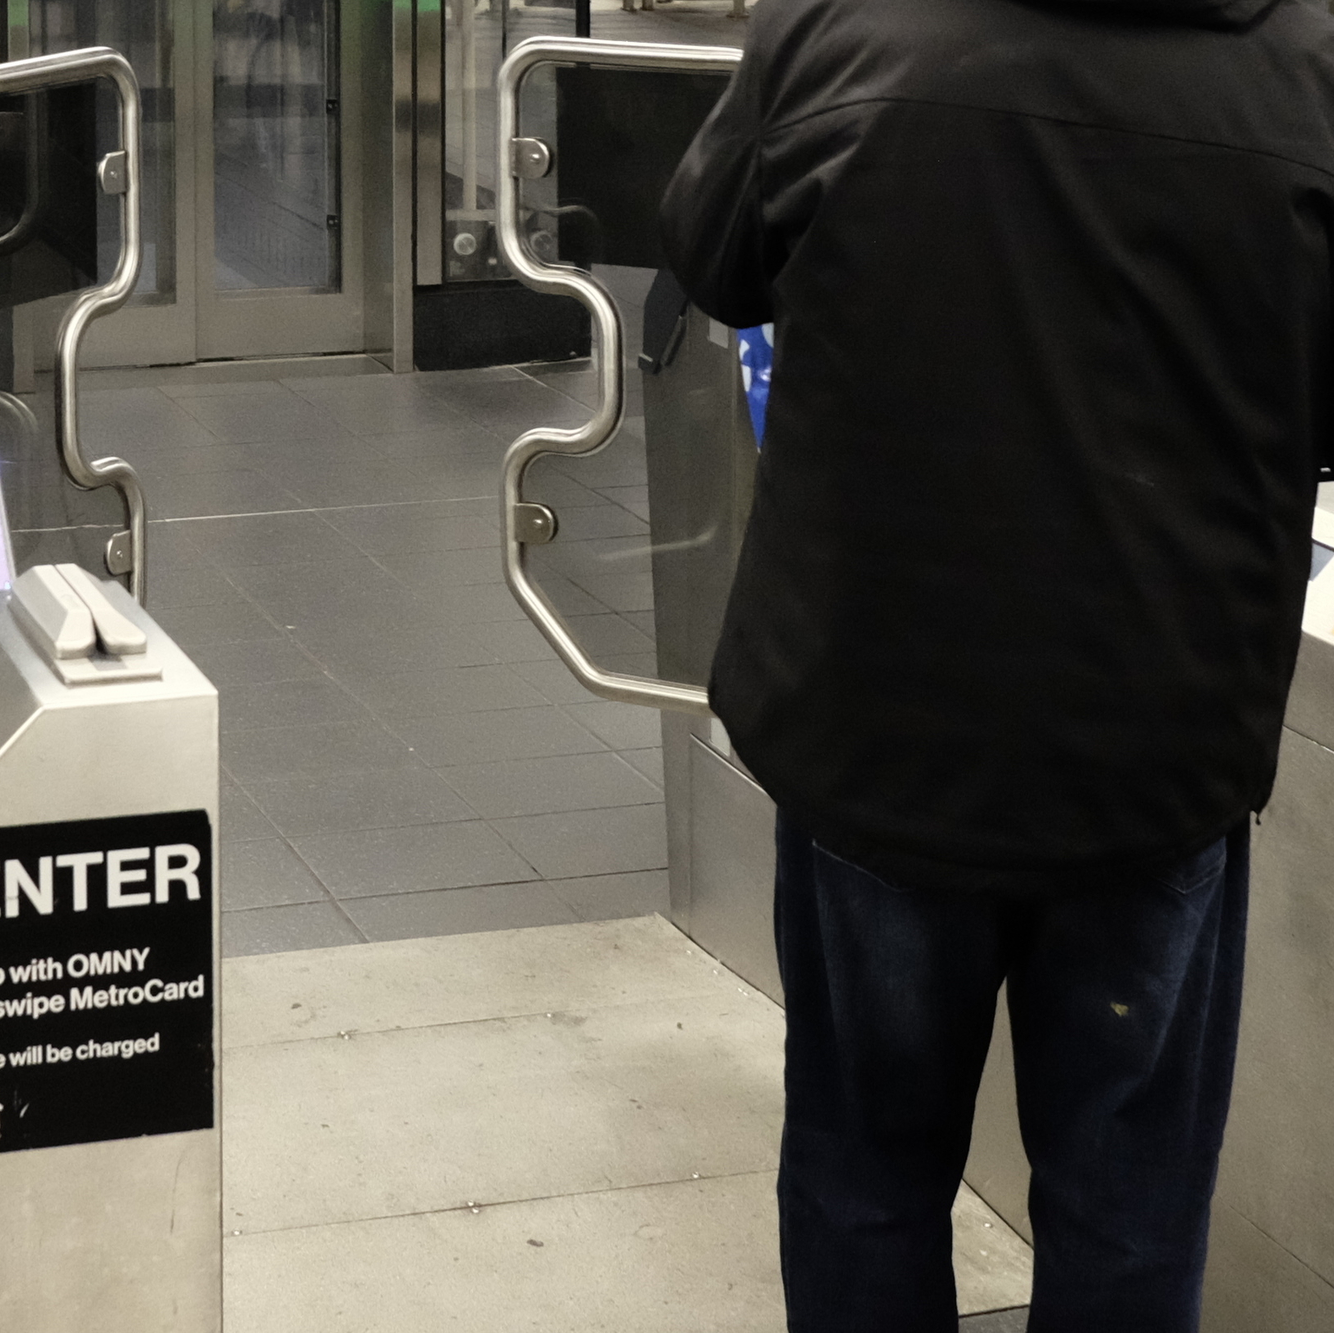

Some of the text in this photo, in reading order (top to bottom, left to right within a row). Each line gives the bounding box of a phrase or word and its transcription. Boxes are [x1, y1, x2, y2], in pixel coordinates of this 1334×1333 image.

[9, 956, 63, 984] with
[67, 947, 150, 976] OMNY
[70, 975, 204, 1011] MetroCard
[9, 1046, 42, 1066] will
[46, 1043, 72, 1062] be
[76, 1033, 160, 1060] charged
